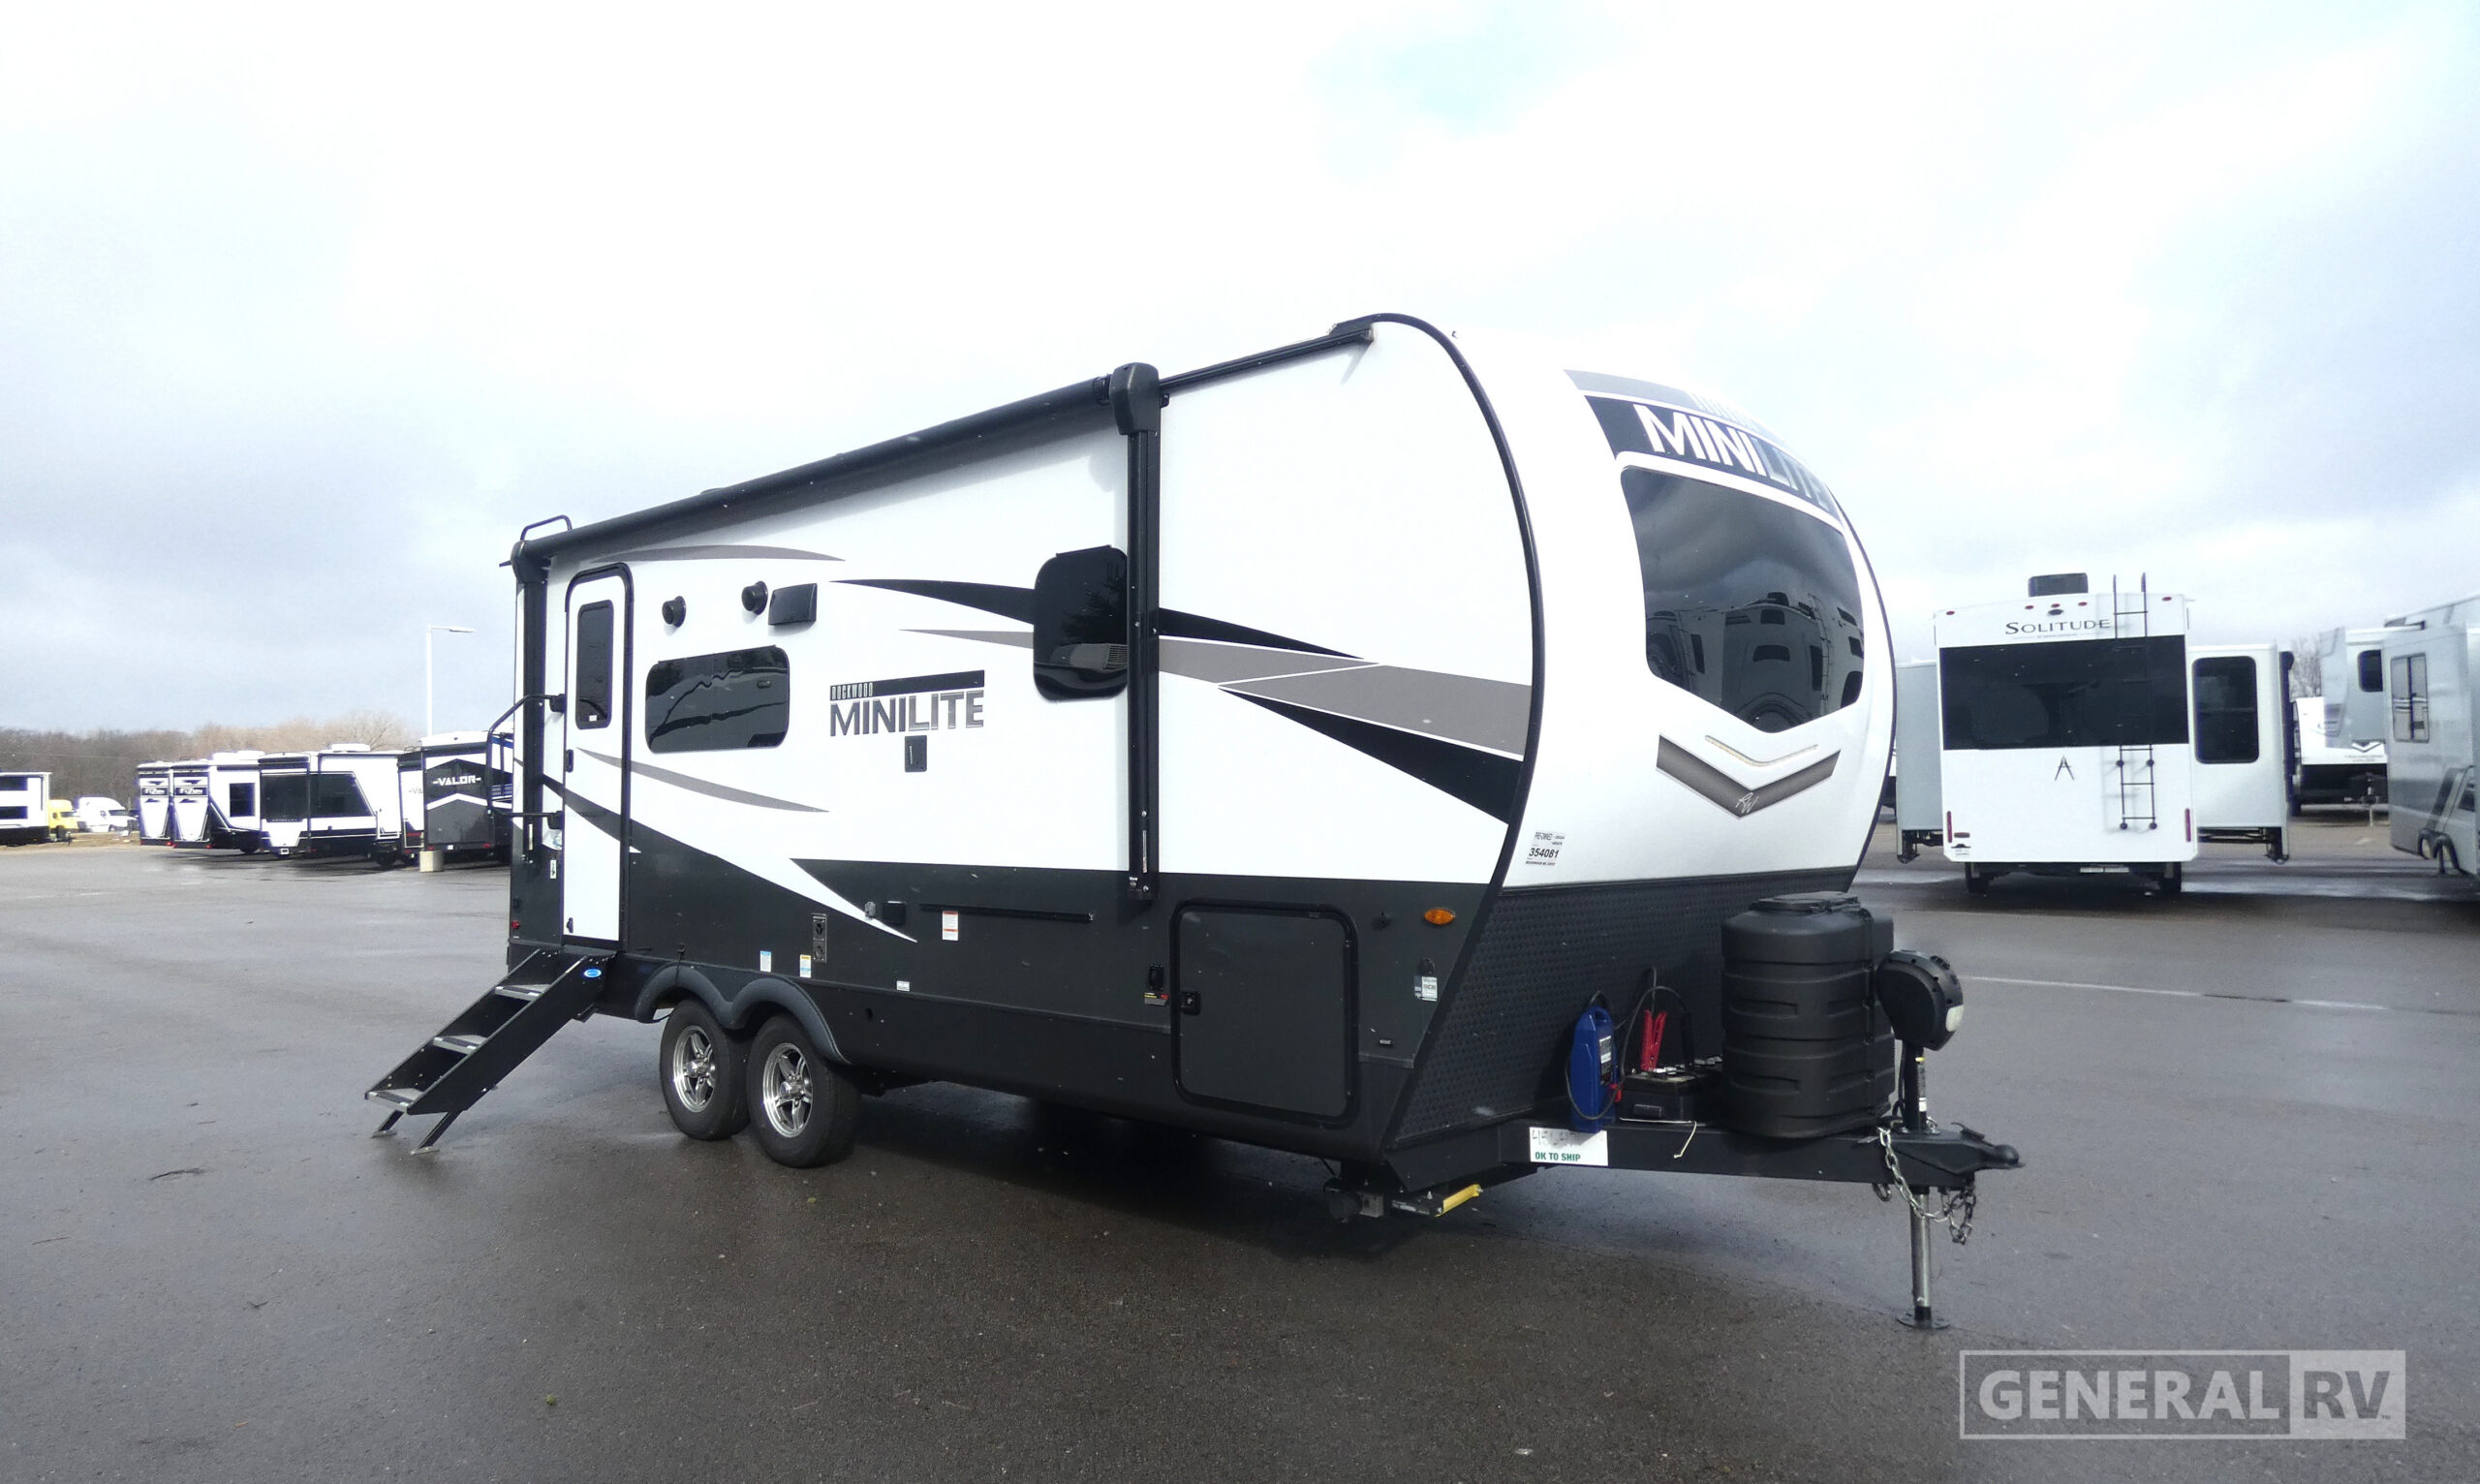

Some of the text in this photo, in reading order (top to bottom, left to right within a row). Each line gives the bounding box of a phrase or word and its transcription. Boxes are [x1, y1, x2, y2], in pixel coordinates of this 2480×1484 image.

[2005, 620, 2111, 635] SOLITUDE
[829, 689, 985, 737] MINILITE
[438, 774, 478, 787] VALOR
[1528, 847, 1560, 859] 354081
[1534, 1151, 1581, 1162] OK TO SHIP
